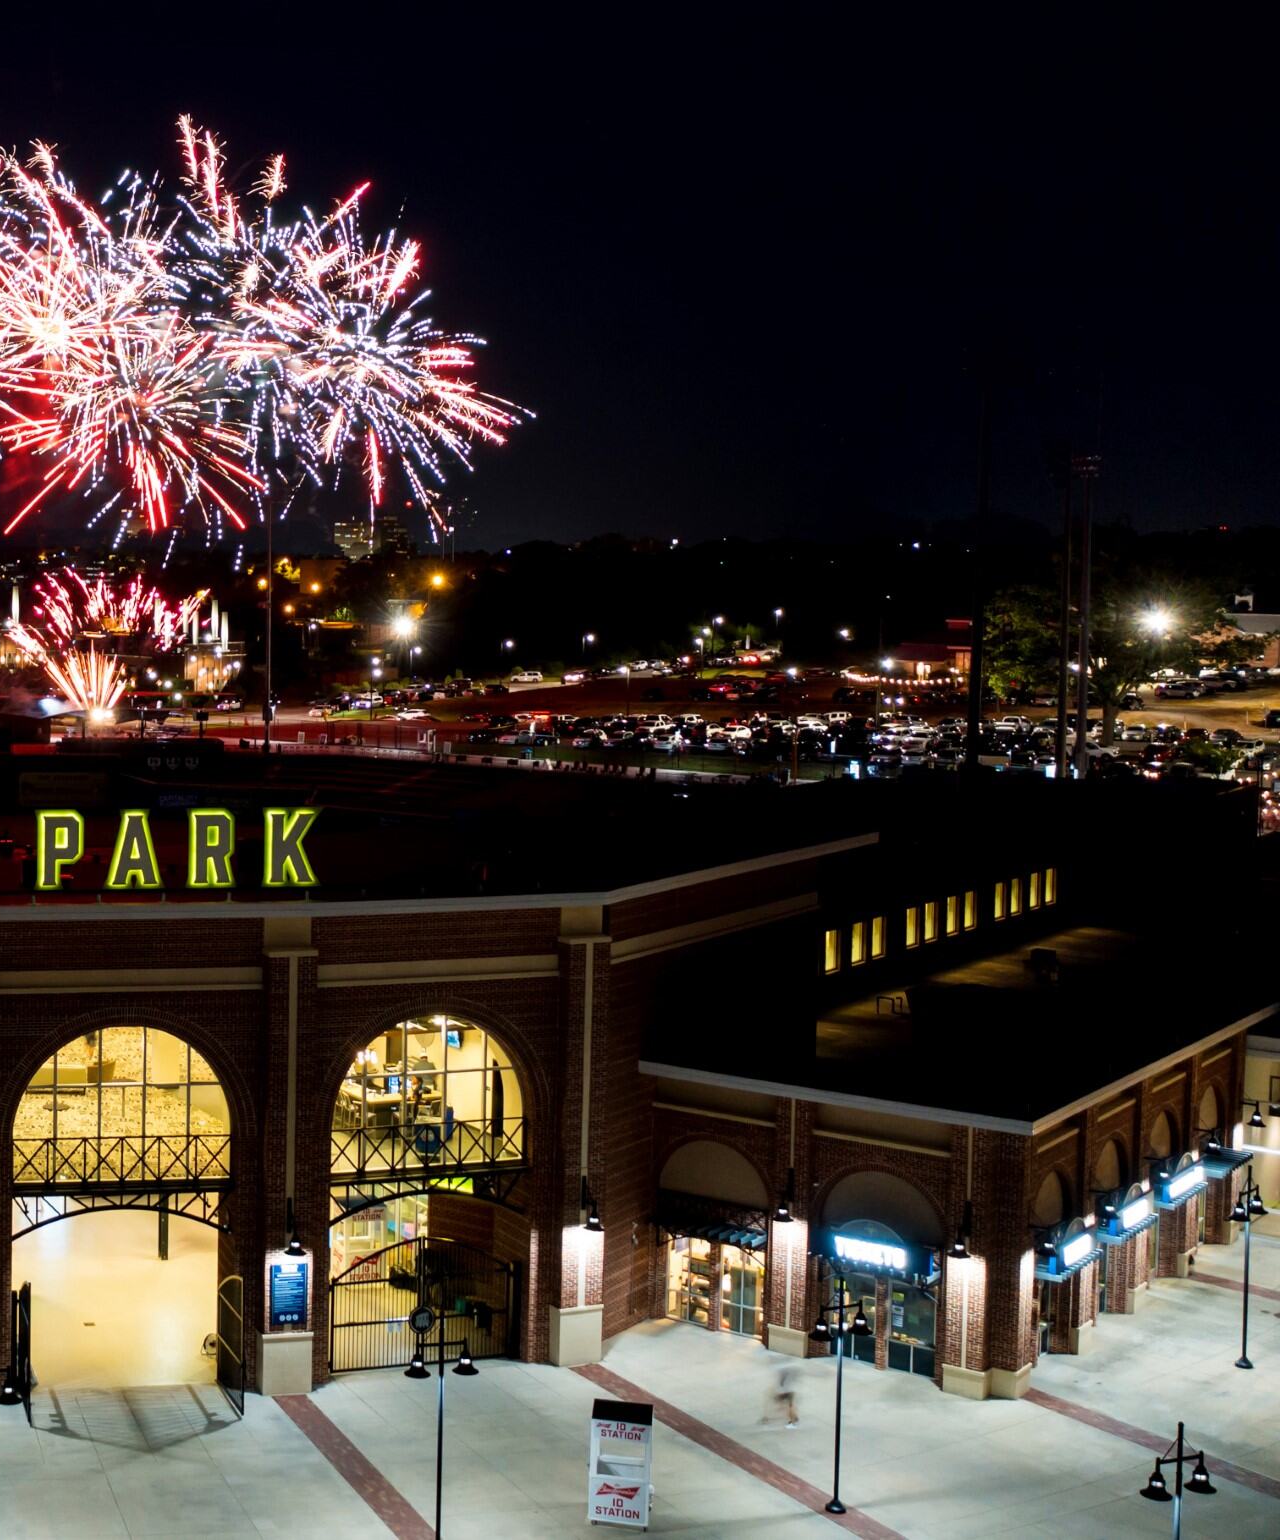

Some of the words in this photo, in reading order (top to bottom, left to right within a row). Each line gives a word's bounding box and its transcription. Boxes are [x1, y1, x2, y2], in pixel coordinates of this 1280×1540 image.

[36, 807, 320, 891] PARK
[616, 1422, 626, 1431] ID
[600, 1428, 641, 1441] STATION
[612, 1498, 624, 1508] ID
[595, 1506, 640, 1519] STATION
